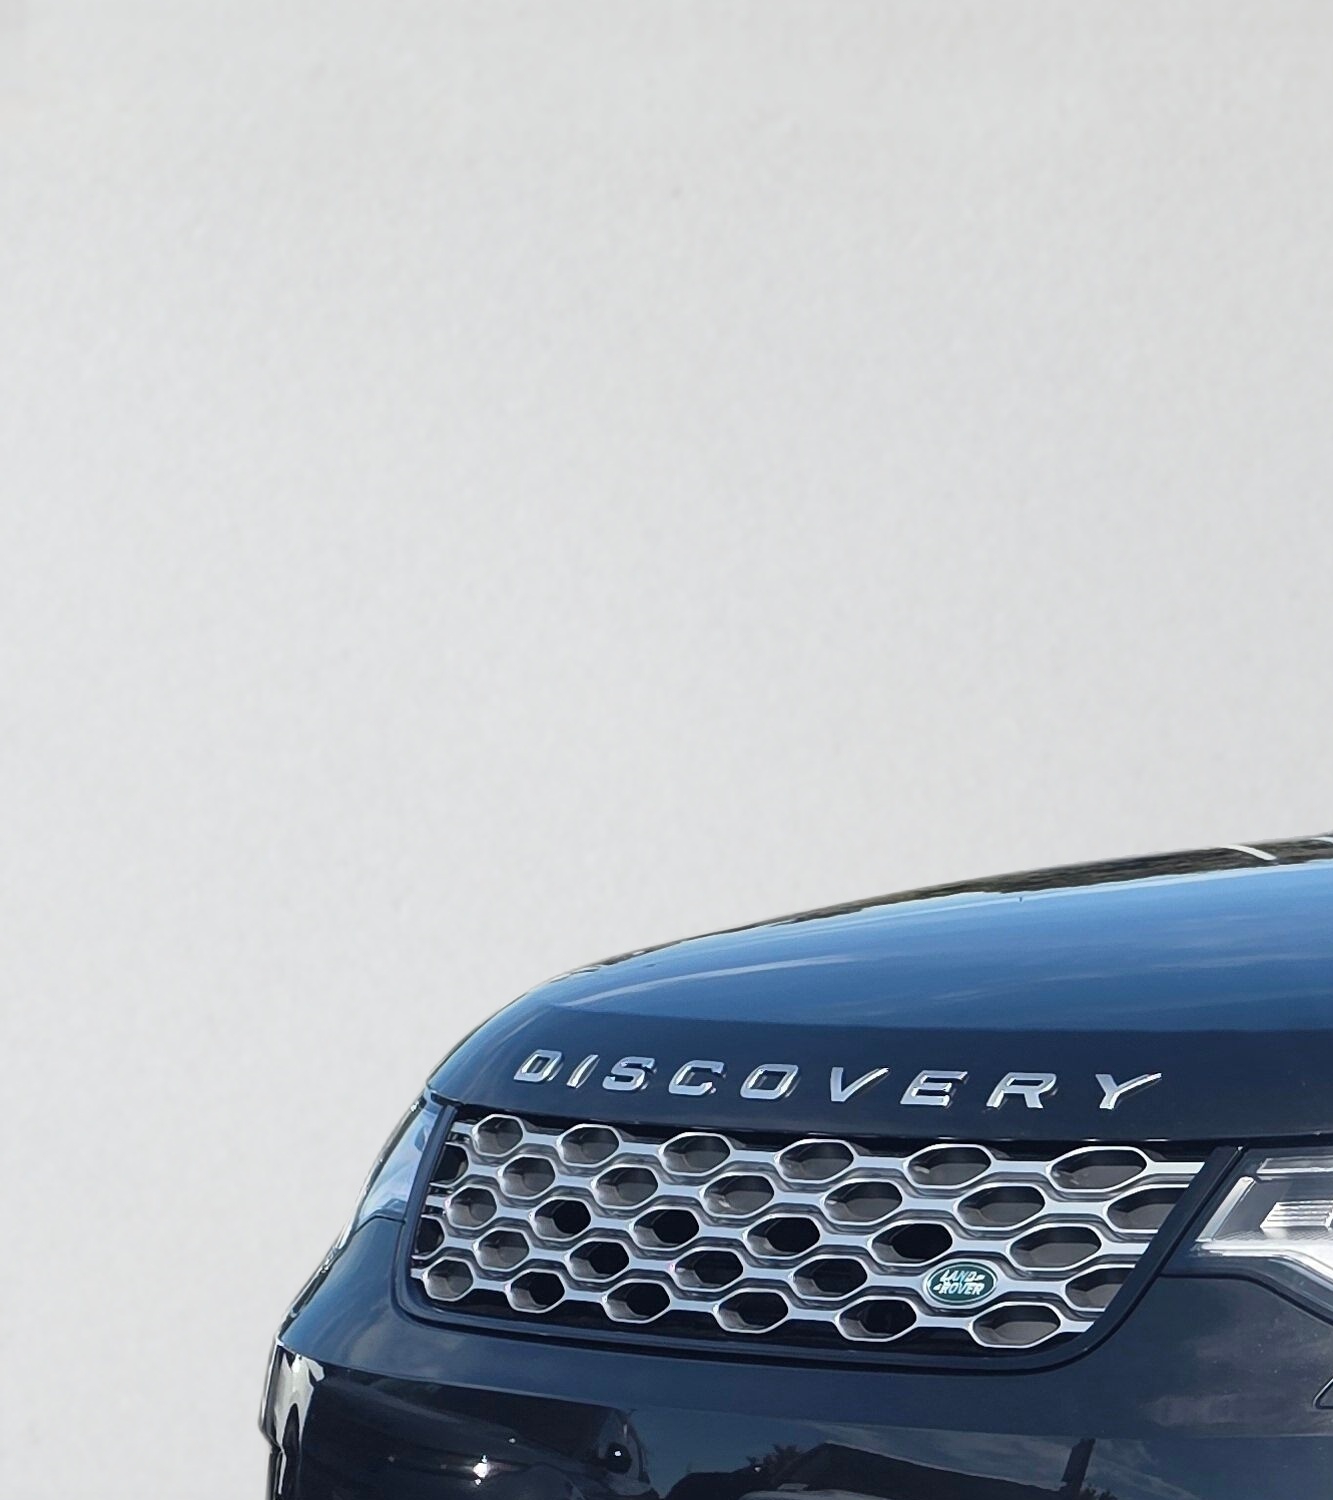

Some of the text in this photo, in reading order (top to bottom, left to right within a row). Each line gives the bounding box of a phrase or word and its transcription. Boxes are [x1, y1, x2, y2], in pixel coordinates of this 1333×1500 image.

[513, 1049, 1162, 1111] DISCOVERY
[939, 1269, 978, 1282] LAND
[938, 1280, 985, 1295] ROVER
